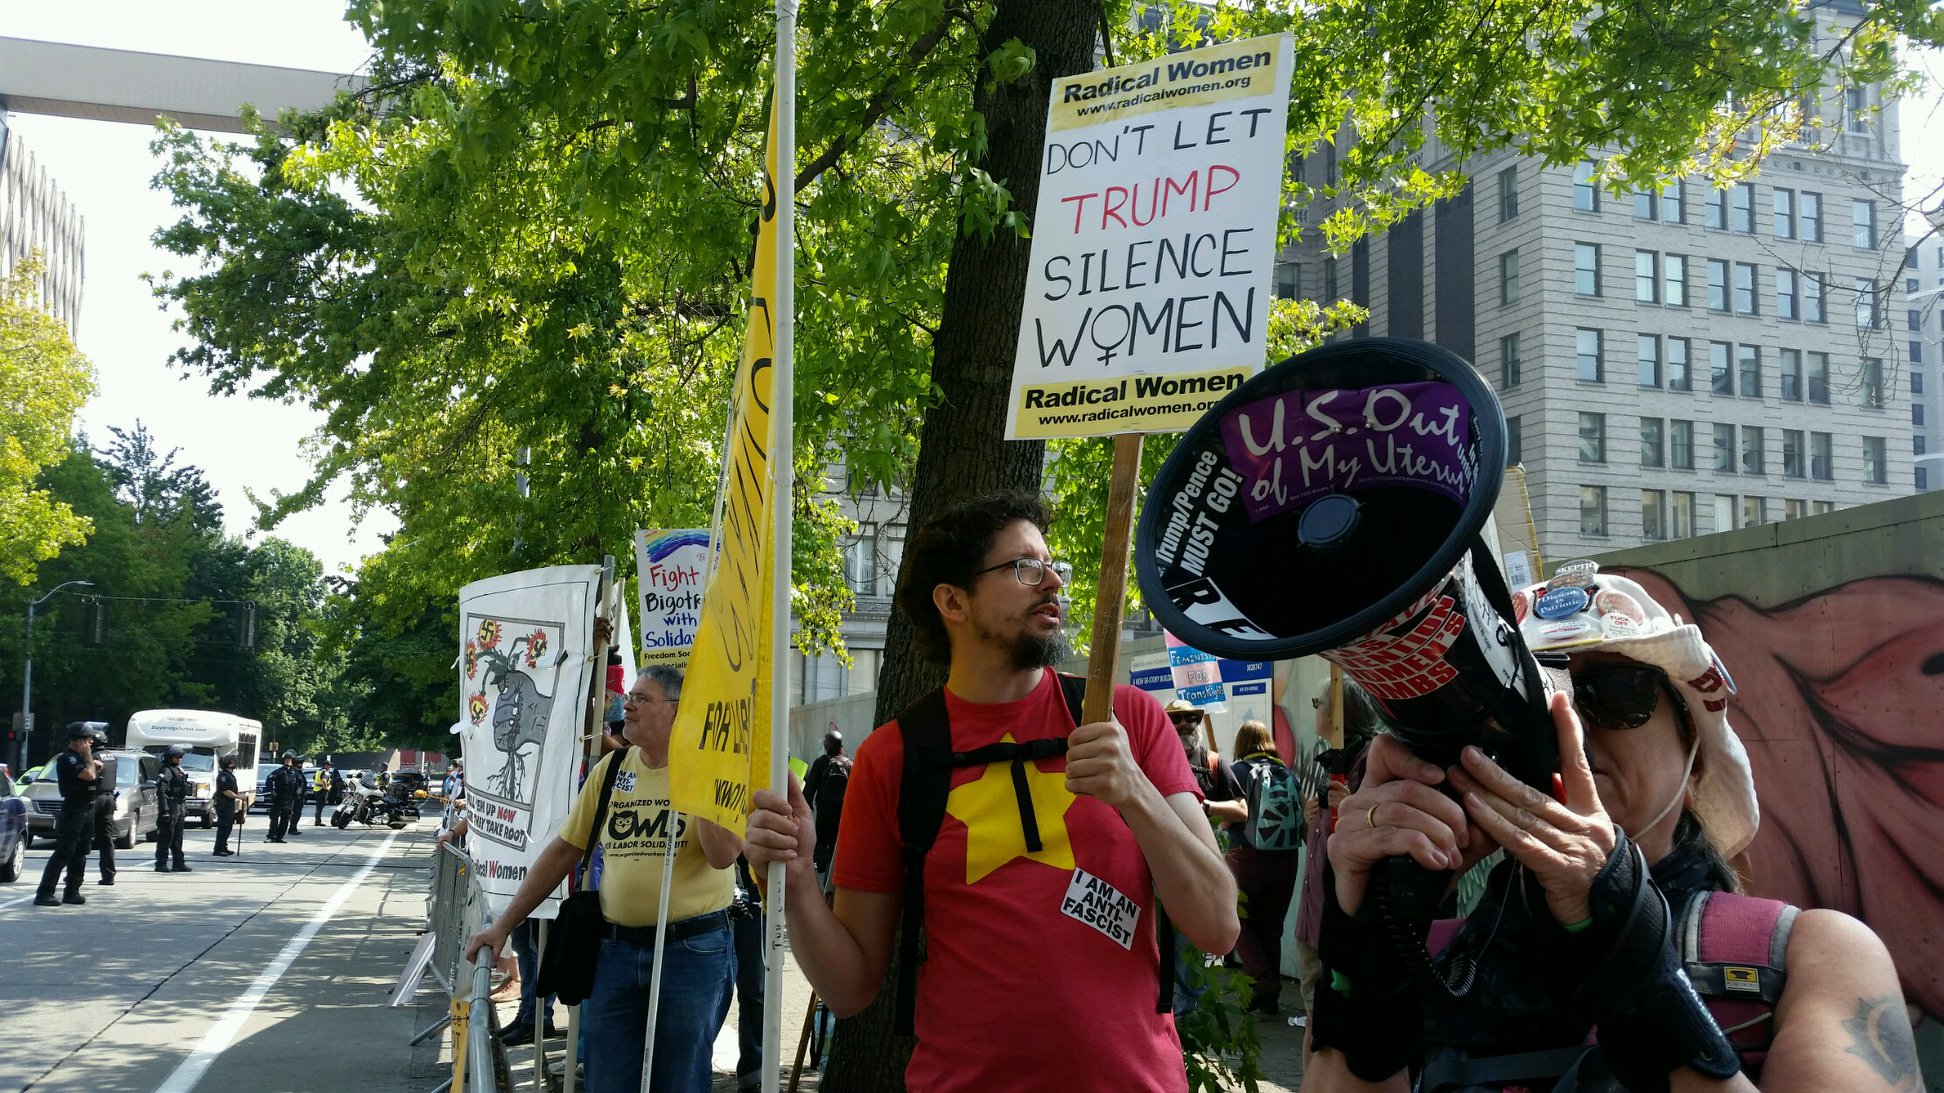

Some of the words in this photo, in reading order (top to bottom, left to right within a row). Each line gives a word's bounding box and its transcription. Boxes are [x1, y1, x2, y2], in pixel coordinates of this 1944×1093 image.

[1063, 67, 1160, 104] Radical
[1168, 51, 1271, 83] Women
[1077, 76, 1251, 116] www.radicalwomen.org
[1047, 125, 1154, 175] DON'T
[1173, 108, 1272, 150] LET
[1061, 165, 1240, 234] TRUMP
[1044, 228, 1254, 301] SILENCE
[1035, 287, 1255, 368] WOMEN
[1025, 380, 1127, 409] Radical
[1135, 373, 1244, 399] Women
[1362, 388, 1460, 446] Out
[1300, 444, 1362, 489] My
[1155, 451, 1218, 564] Trump/Pence
[1180, 511, 1220, 577] MUST
[1206, 467, 1244, 513] GO!
[649, 564, 700, 592] Fight
[646, 628, 695, 648] Solida
[663, 612, 698, 627] with
[644, 651, 676, 660] Freedom
[1187, 669, 1210, 684] FOR
[486, 803, 496, 817] UP
[655, 799, 670, 807] WO
[486, 819, 504, 836] TAKE
[613, 841, 638, 849] LABOR
[489, 860, 527, 881] Women
[1075, 870, 1084, 884] I
[1085, 877, 1114, 901] AM
[1116, 896, 1137, 919] AN
[1082, 891, 1123, 922] ANTI-
[1063, 897, 1131, 945] FASCIST
